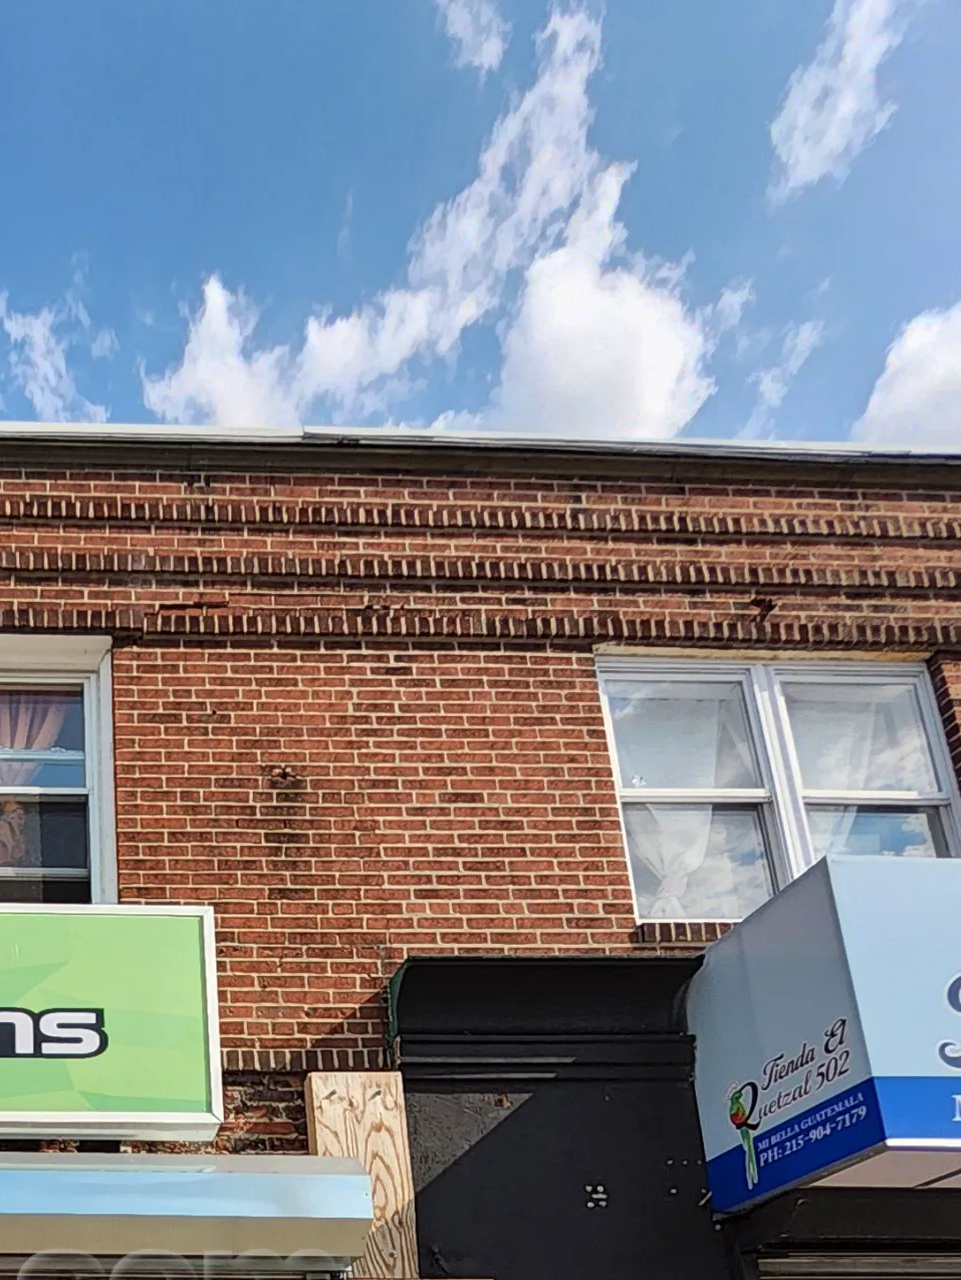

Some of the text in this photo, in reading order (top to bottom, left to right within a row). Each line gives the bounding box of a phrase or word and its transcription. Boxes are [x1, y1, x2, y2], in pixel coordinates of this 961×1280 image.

[763, 1017, 848, 1091] Tienda El
[736, 1049, 850, 1131] Quetzal 502
[757, 1092, 865, 1151] MI BELLA GUATEMALA
[759, 1105, 867, 1167] PH: 215-904-7179
